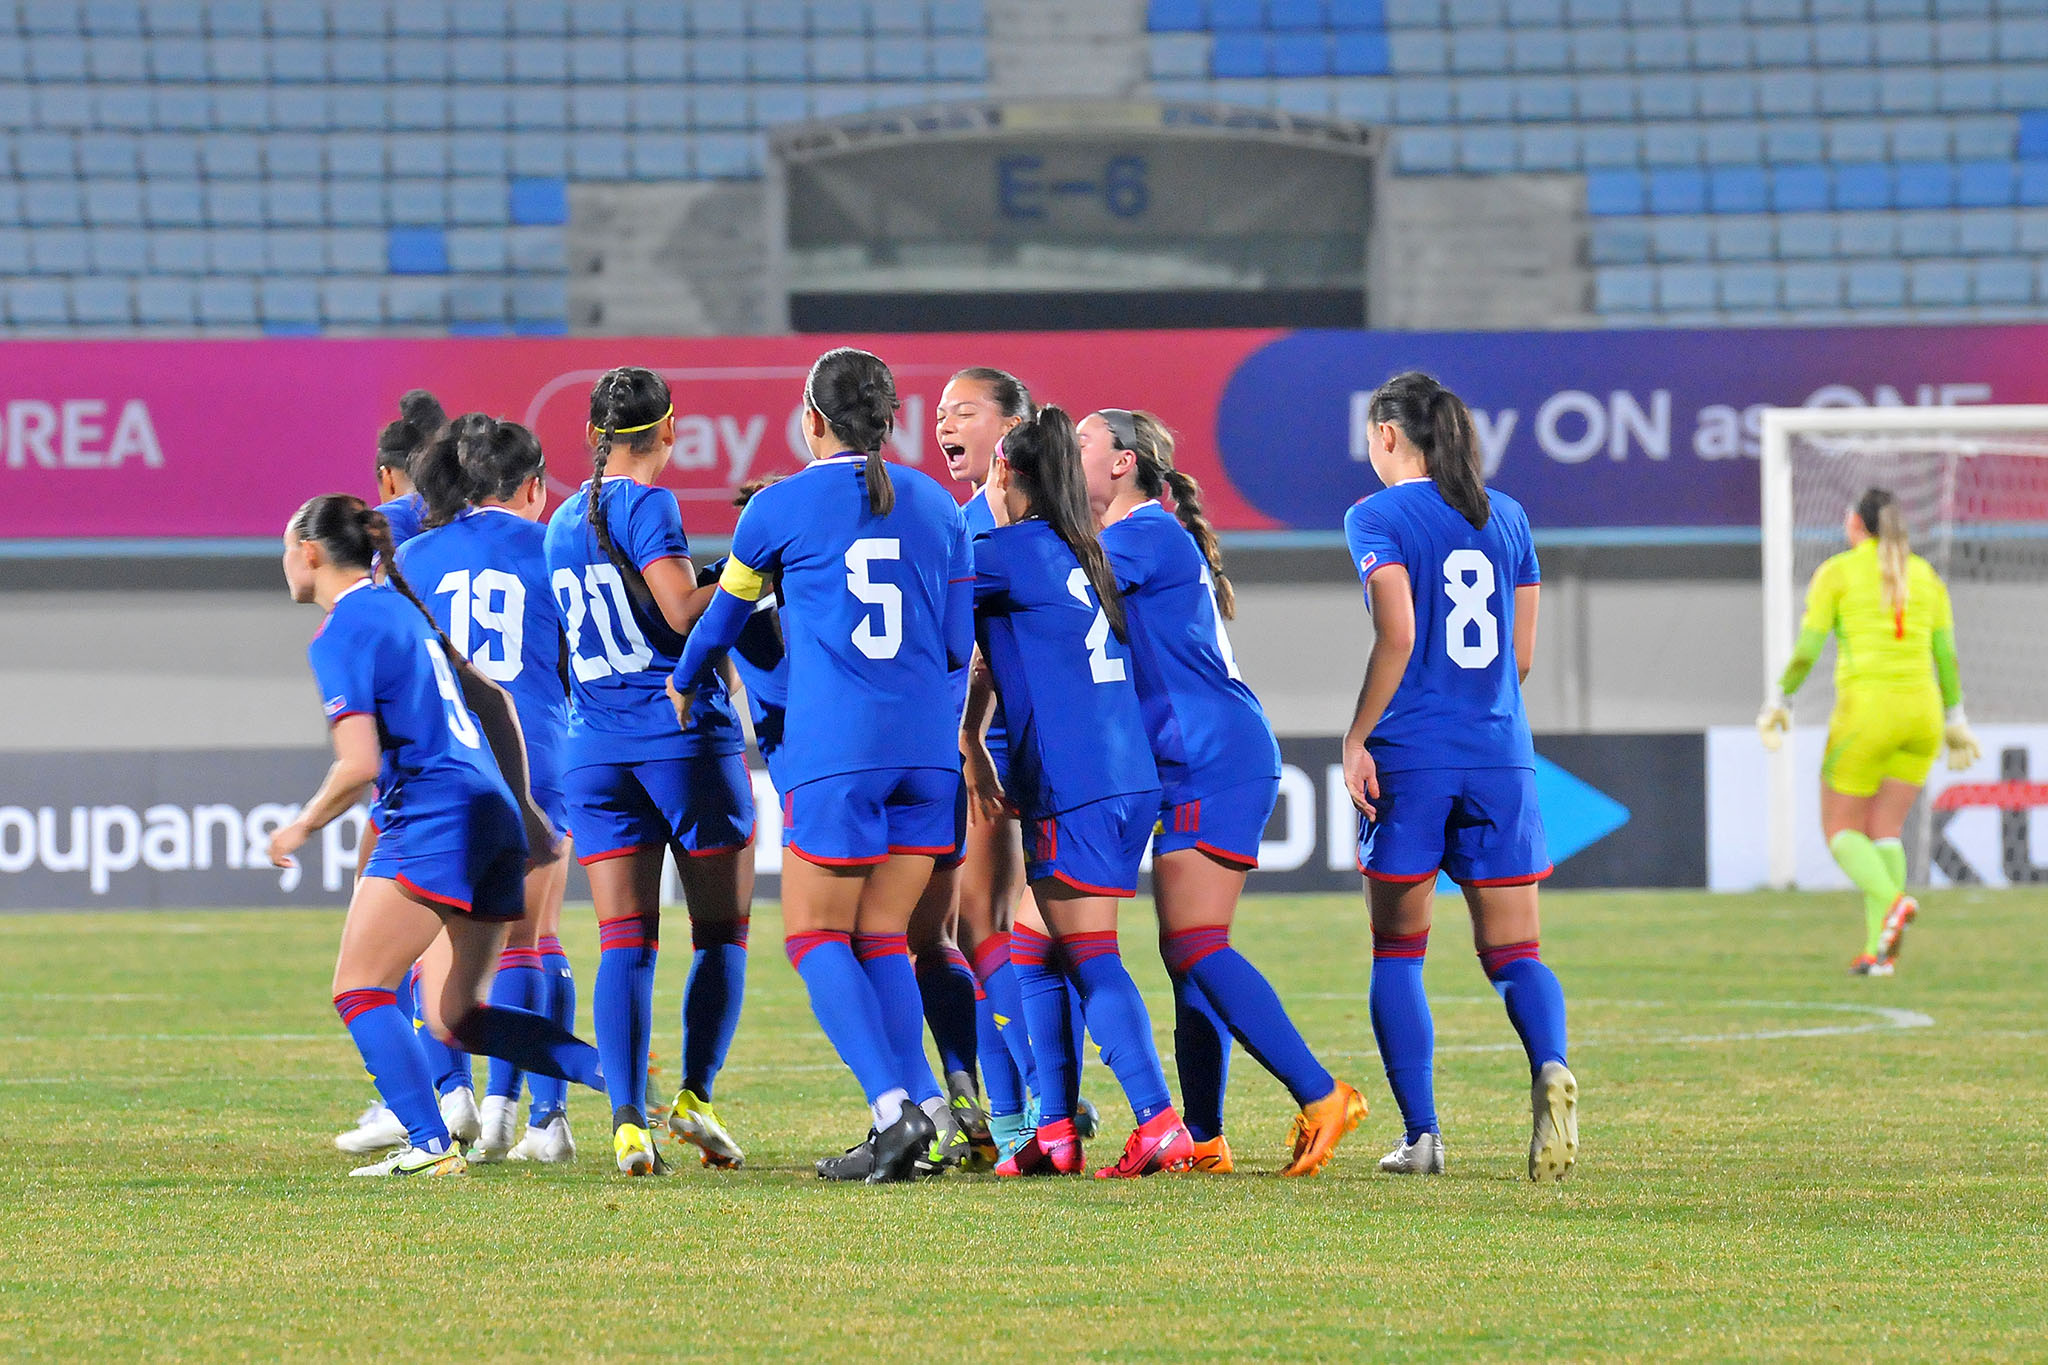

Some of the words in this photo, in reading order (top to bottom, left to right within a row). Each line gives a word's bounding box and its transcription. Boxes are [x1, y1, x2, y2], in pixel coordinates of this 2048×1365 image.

[996, 154, 1149, 219] E-6
[0, 398, 164, 468] REA
[1535, 389, 1672, 463] ON
[434, 567, 527, 682] 19
[552, 563, 654, 683] 20
[844, 538, 903, 660] 5
[1066, 567, 1127, 684] 2
[1443, 549, 1500, 669] 8
